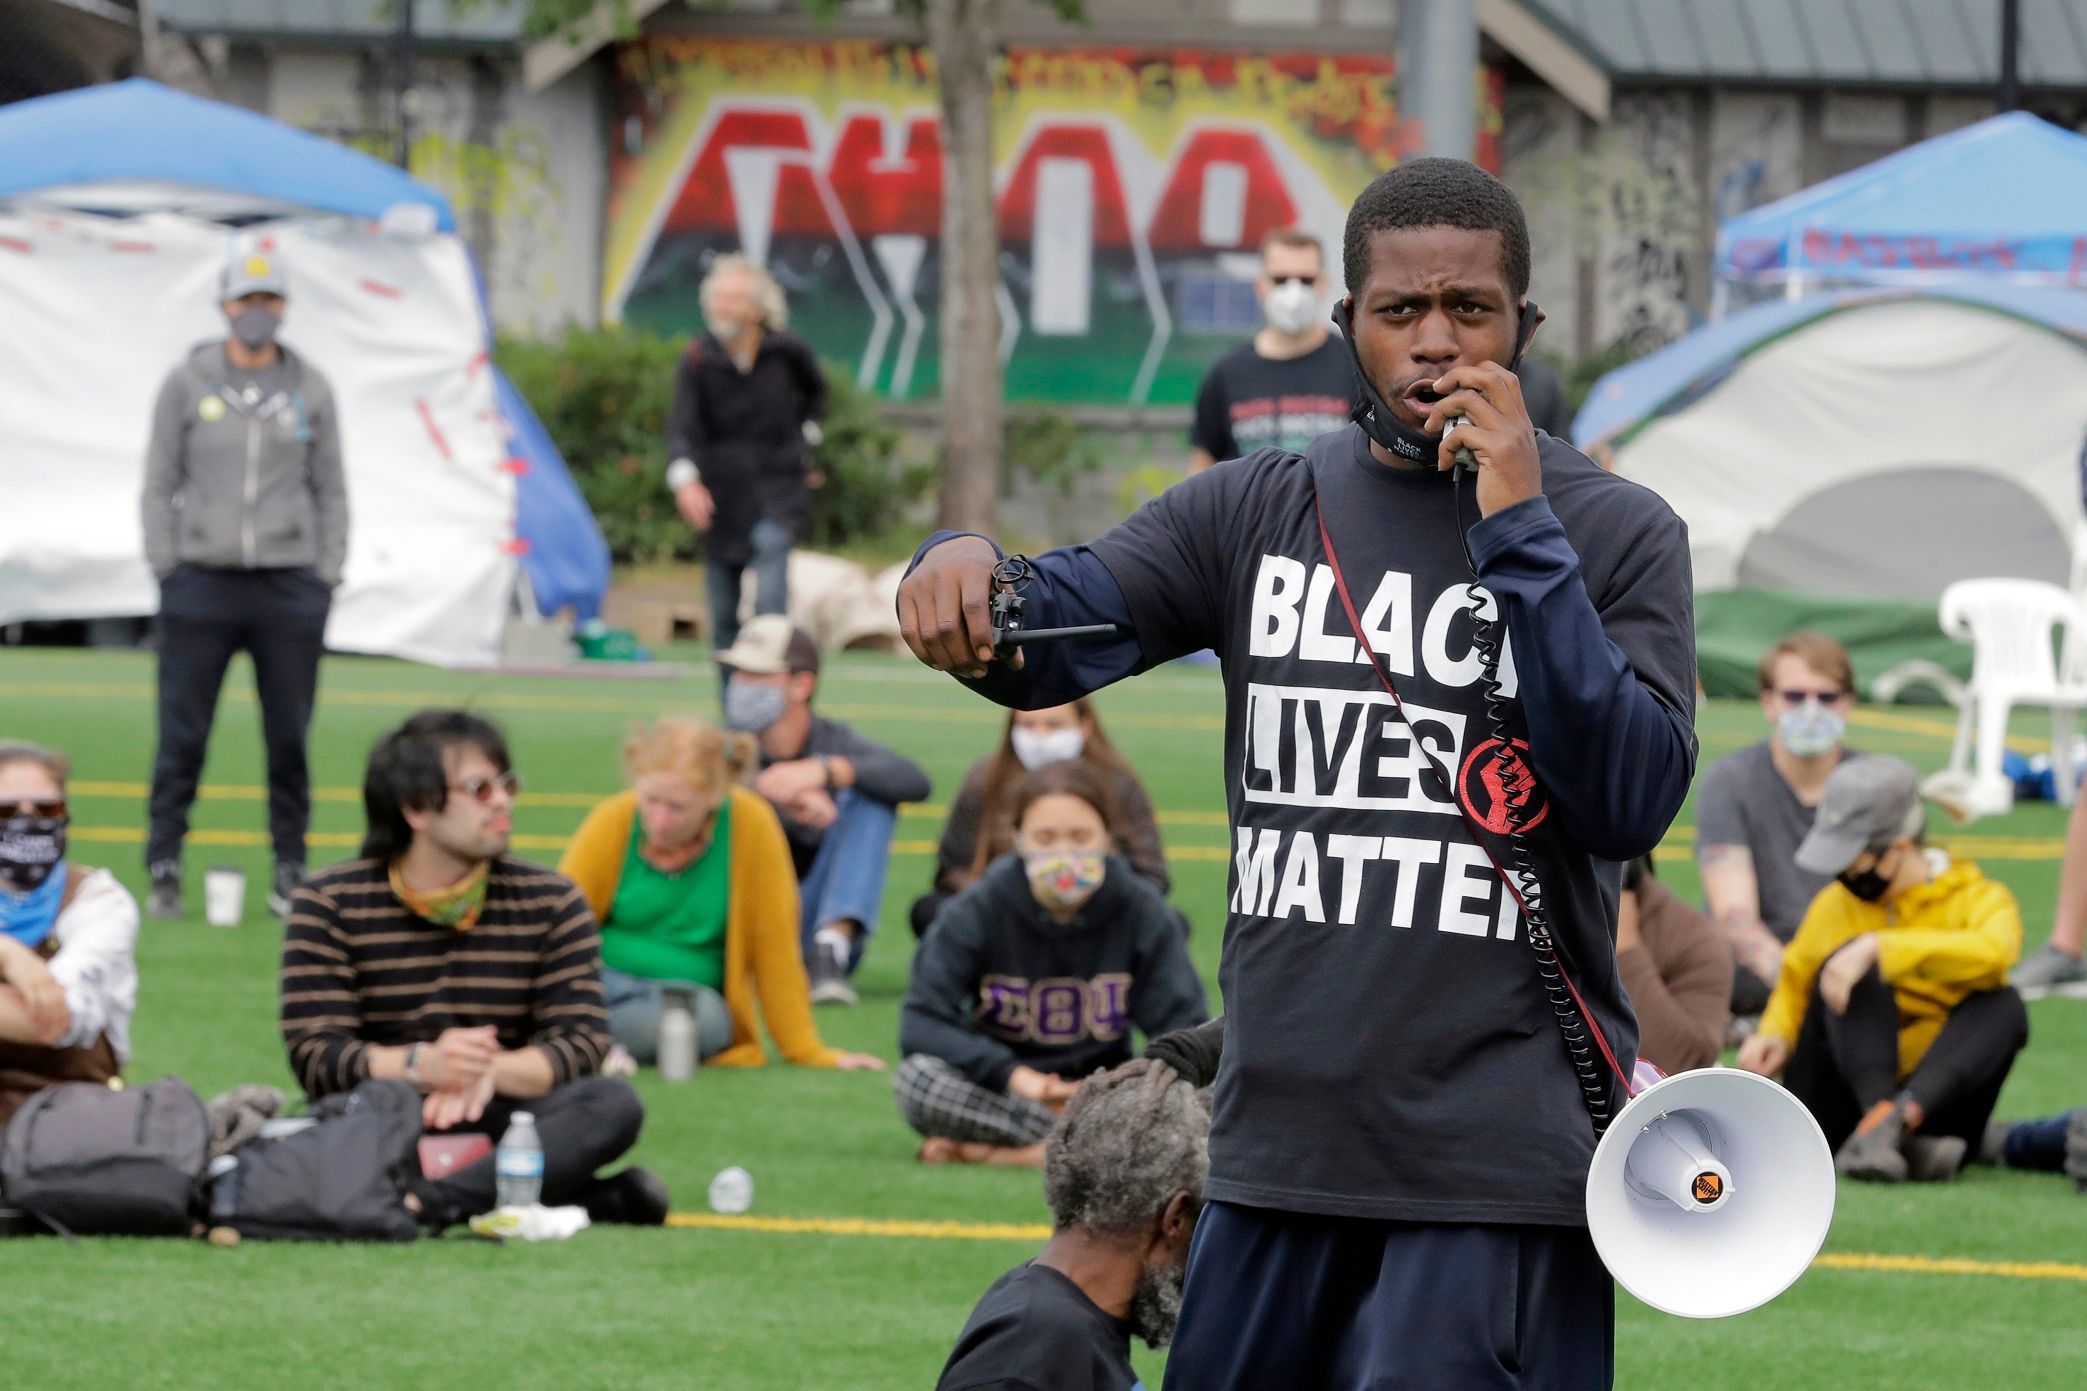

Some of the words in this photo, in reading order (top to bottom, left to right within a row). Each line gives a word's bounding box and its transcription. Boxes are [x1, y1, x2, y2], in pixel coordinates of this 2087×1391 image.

[1397, 437, 1421, 453] BLACK
[1249, 554, 1519, 699] BLAC
[1245, 690, 1457, 805] LIVES
